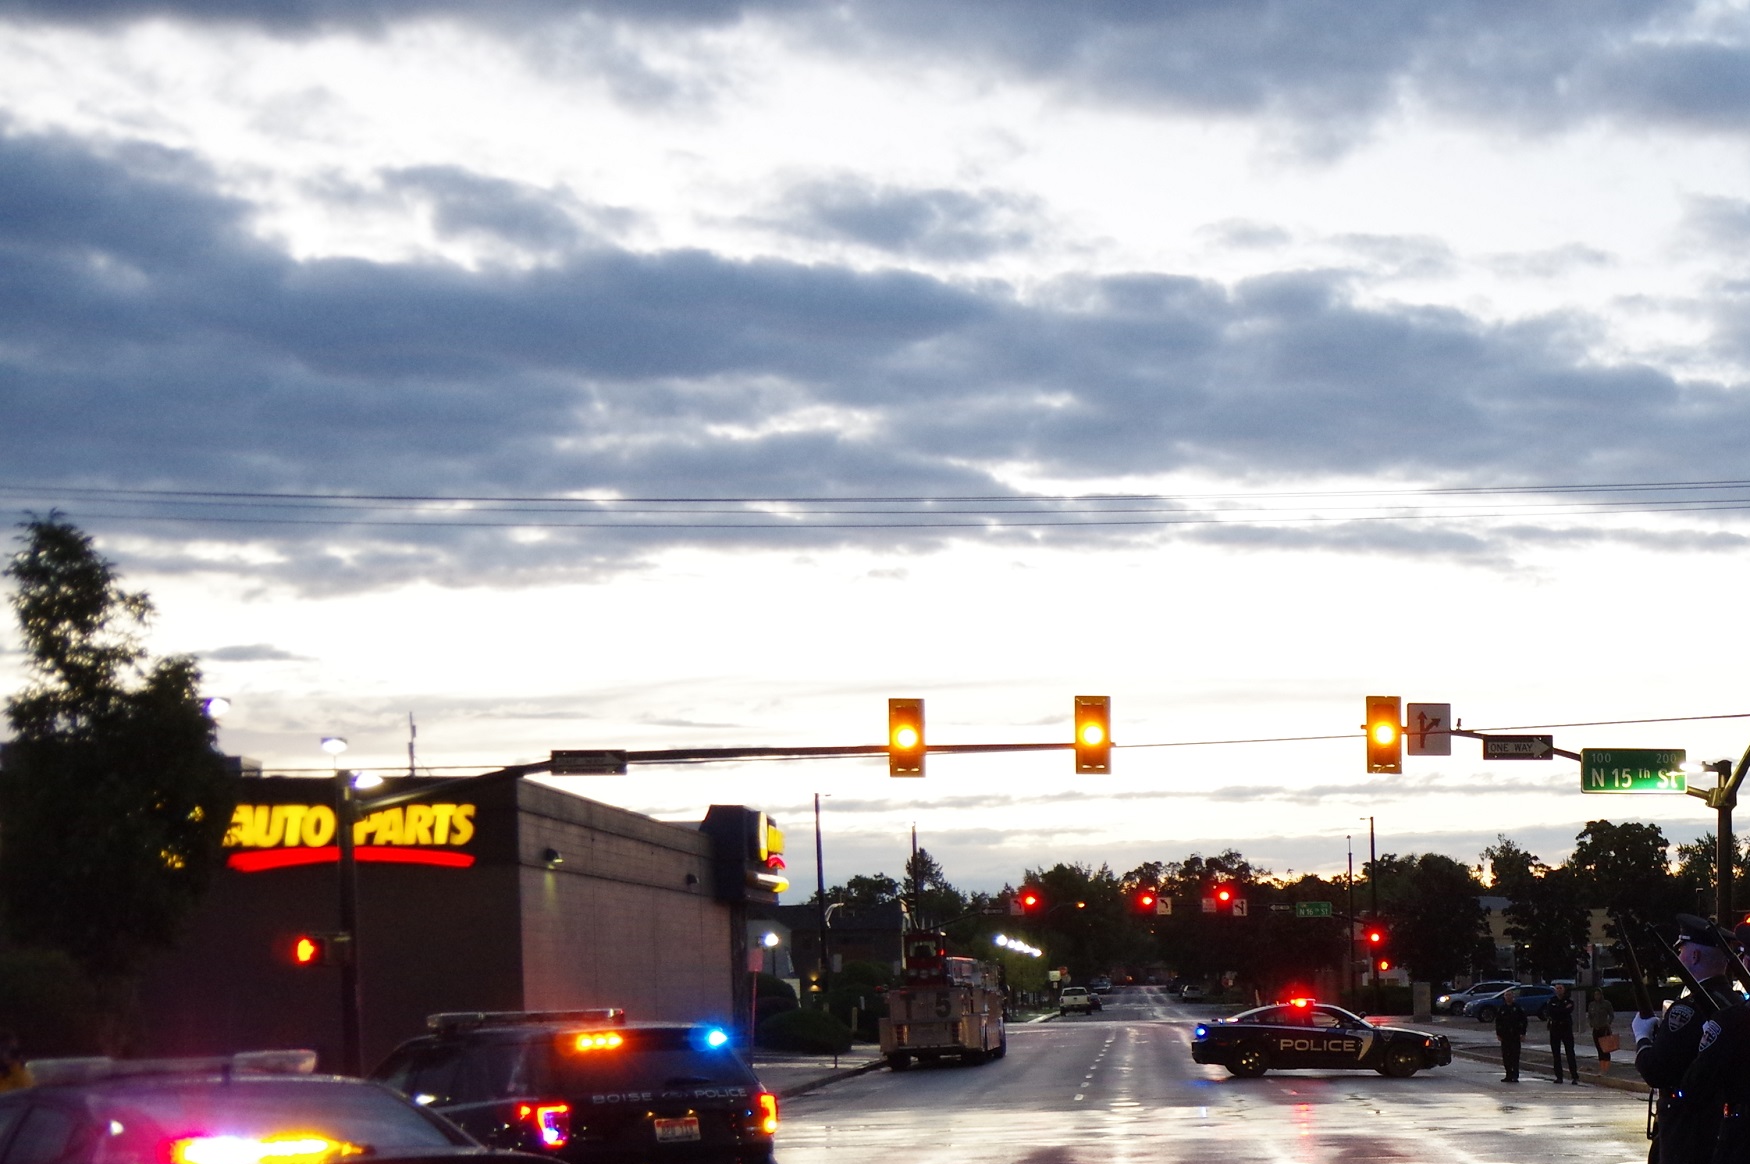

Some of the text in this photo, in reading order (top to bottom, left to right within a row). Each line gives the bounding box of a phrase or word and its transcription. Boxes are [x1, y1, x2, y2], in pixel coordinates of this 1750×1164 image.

[1490, 743, 1533, 752] ONE WAY
[1592, 753, 1677, 764] 100 200
[1591, 768, 1605, 788] N
[1611, 768, 1633, 788] 15
[1657, 769, 1679, 788] St
[222, 803, 476, 848] AUTO PARTS
[935, 992, 951, 1018] 5
[1280, 1039, 1356, 1051] POLICE
[593, 1088, 747, 1103] BOISE POLICE
